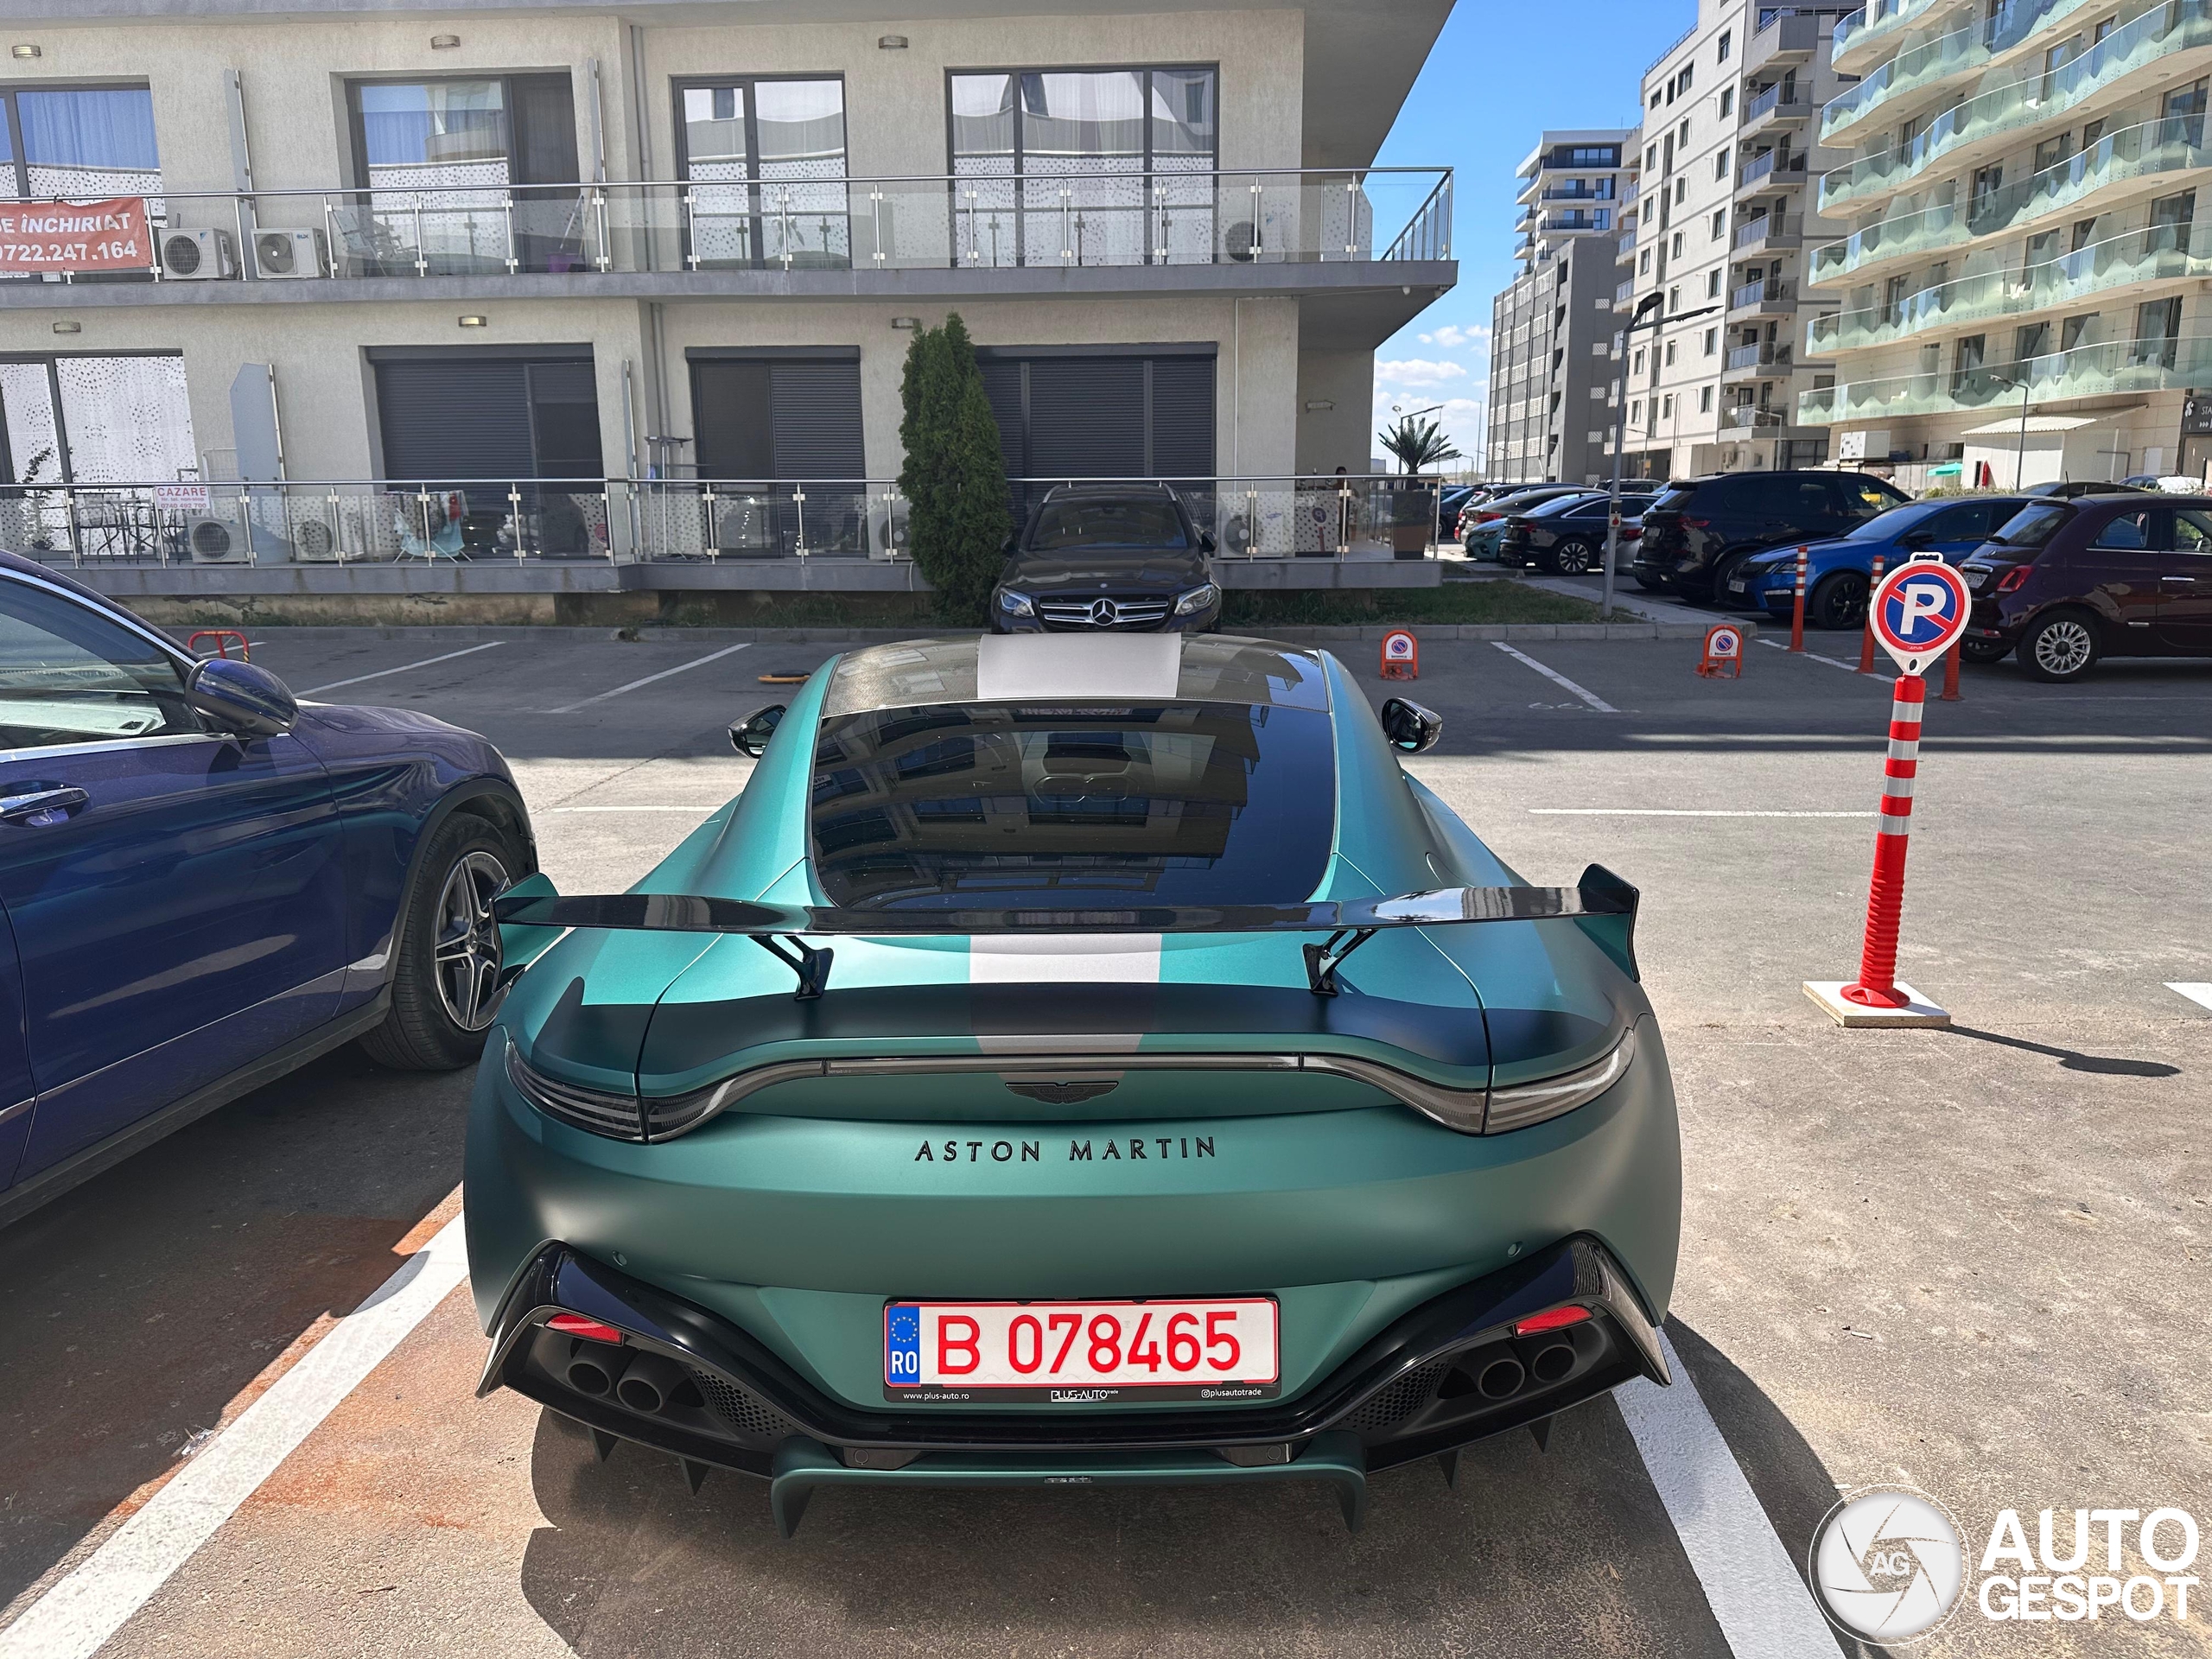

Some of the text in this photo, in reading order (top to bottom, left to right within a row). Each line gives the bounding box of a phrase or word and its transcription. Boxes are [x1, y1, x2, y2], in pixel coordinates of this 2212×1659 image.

[0, 213, 130, 233] E ÎNCHIRIAT
[0, 240, 137, 261] 722.247.164
[157, 487, 207, 496] CAZARE
[1900, 583, 1947, 635] P
[914, 1136, 1216, 1162] ASTON MARTIN
[938, 1311, 1241, 1375] B 078465
[892, 1351, 918, 1375] RO
[903, 1392, 969, 1401] www.plus-auto.ro
[1051, 1389, 1107, 1402] PLUS-AUTO
[1210, 1388, 1262, 1398] plusautotrade
